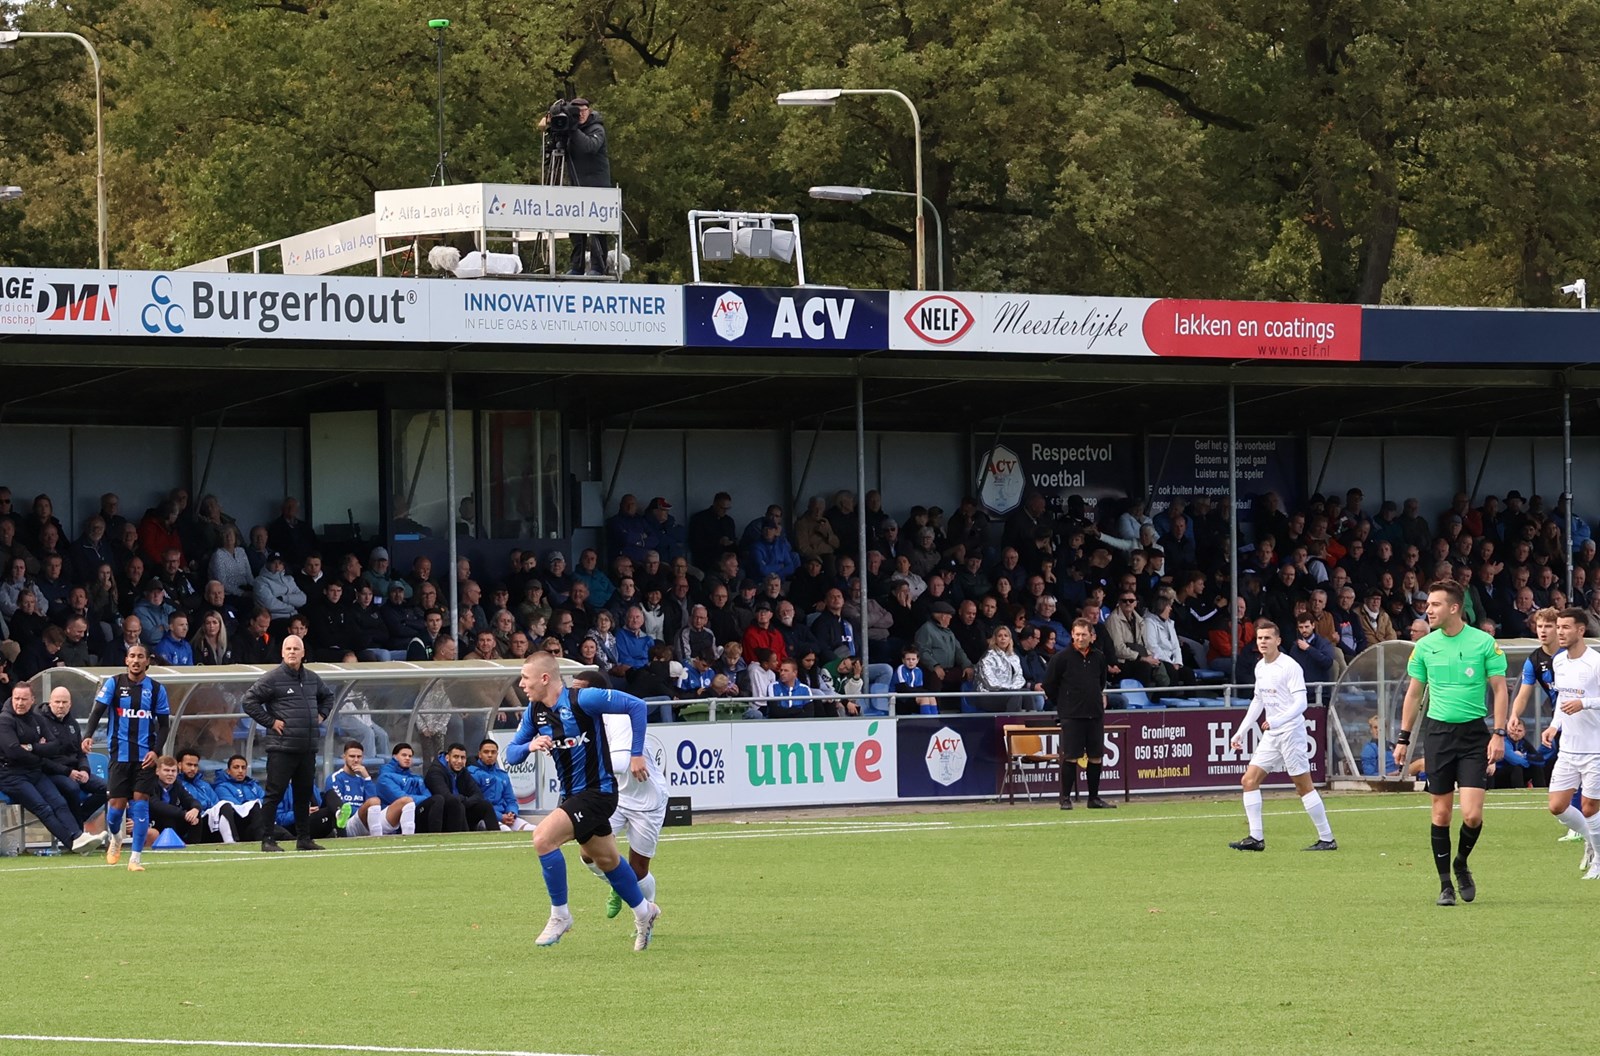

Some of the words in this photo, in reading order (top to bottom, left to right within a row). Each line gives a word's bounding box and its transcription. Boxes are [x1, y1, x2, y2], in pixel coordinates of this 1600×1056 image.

[398, 206, 421, 220] Alfa
[424, 202, 454, 218] Laval
[457, 200, 479, 219] Agri
[513, 198, 542, 216] Alfa
[546, 199, 585, 217] Laval
[589, 201, 619, 223] Agri
[304, 247, 325, 262] Alfa
[327, 236, 356, 257] Laval
[464, 292, 576, 314] INNOVATIVE
[582, 295, 666, 315] PARTNER
[464, 318, 475, 329] IN
[478, 318, 504, 330] FLUE
[507, 318, 529, 331] GAS
[531, 319, 538, 331] &
[540, 319, 608, 332] VENTILATION
[610, 320, 667, 333] SOLUTIONS
[771, 296, 855, 341] ACV
[920, 307, 960, 332] NELF
[992, 300, 1129, 350] Meesterlijke
[1174, 312, 1231, 336] lakken
[1237, 319, 1258, 337] en
[1264, 317, 1335, 344] coatings
[1257, 344, 1331, 358] www.nelf.nl
[1031, 443, 1112, 465] Respectvol
[1194, 439, 1210, 450] Geef
[1211, 440, 1222, 450] het
[1244, 440, 1276, 451] voorbeeld
[1195, 454, 1221, 465] Benoem
[1031, 469, 1085, 487] voetbal
[1195, 467, 1218, 479] Luister
[1244, 468, 1265, 481] speler
[1158, 484, 1171, 496] ook
[1171, 484, 1193, 496] buiten
[1141, 724, 1186, 741] Groningen
[745, 721, 882, 787] univé
[1135, 745, 1151, 760] 050
[1153, 744, 1169, 759] 597
[1171, 743, 1193, 758] 3600
[670, 770, 725, 787] RADLER
[1137, 764, 1190, 779] www.hanos.nl
